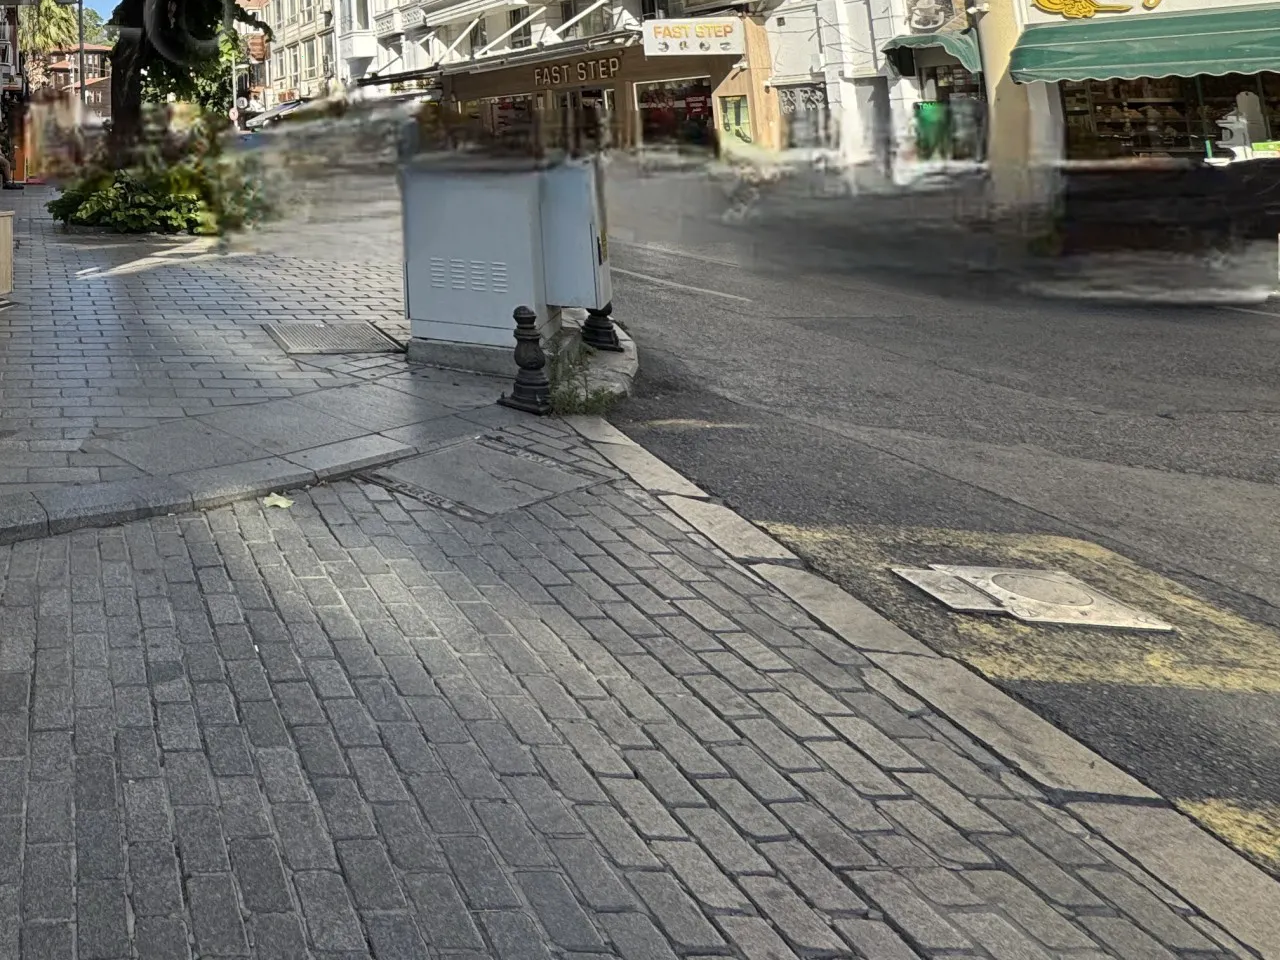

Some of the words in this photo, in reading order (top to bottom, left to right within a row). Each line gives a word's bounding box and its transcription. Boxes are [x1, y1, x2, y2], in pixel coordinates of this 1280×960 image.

[653, 24, 690, 39] FAST
[695, 22, 733, 38] STEP
[534, 65, 569, 86] FAST
[577, 58, 619, 81] STEP
